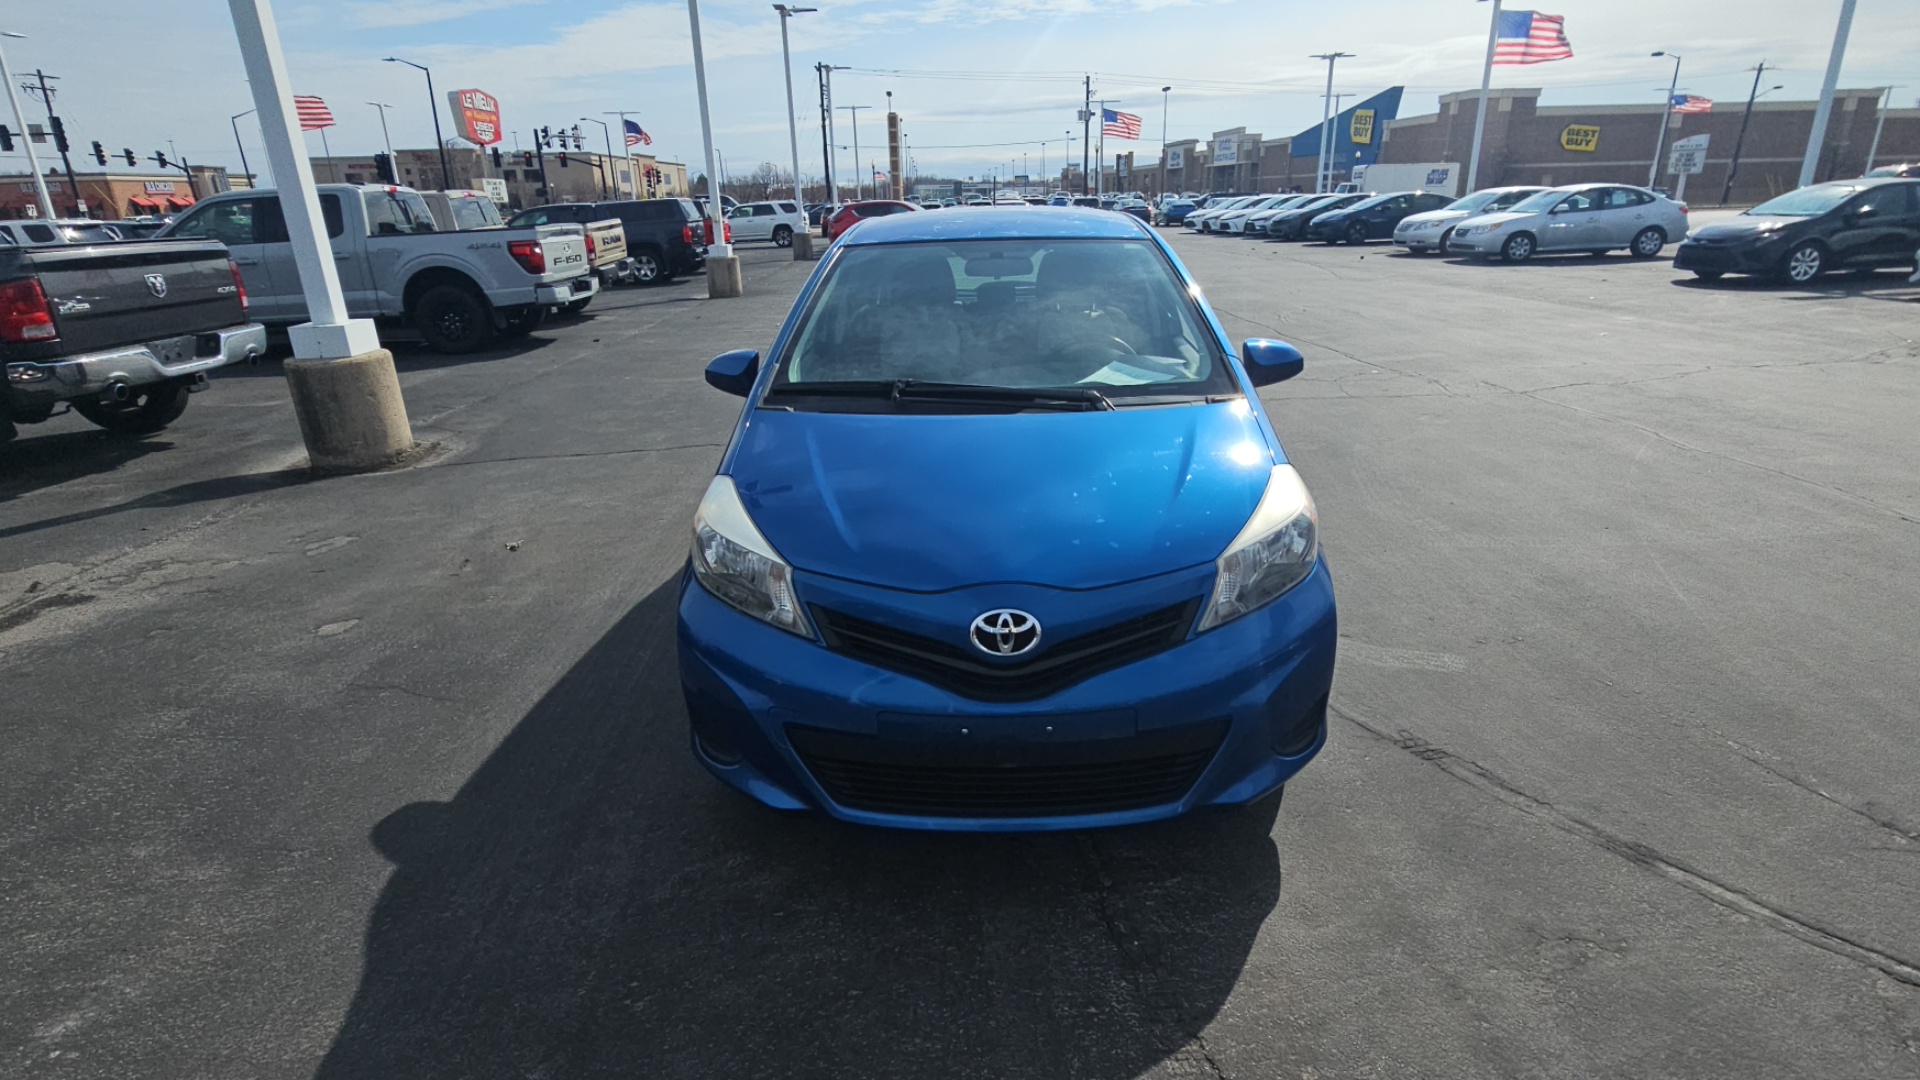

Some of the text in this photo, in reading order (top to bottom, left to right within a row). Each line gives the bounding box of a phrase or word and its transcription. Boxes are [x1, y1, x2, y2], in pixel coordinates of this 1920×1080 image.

[473, 120, 495, 132] USED
[1354, 114, 1373, 126] BEST
[477, 130, 495, 142] CARS
[1353, 126, 1370, 138] BUY
[1566, 128, 1598, 138] BEST
[1565, 137, 1592, 147] BUY
[601, 234, 622, 246] RAM
[553, 253, 583, 266] F-150
